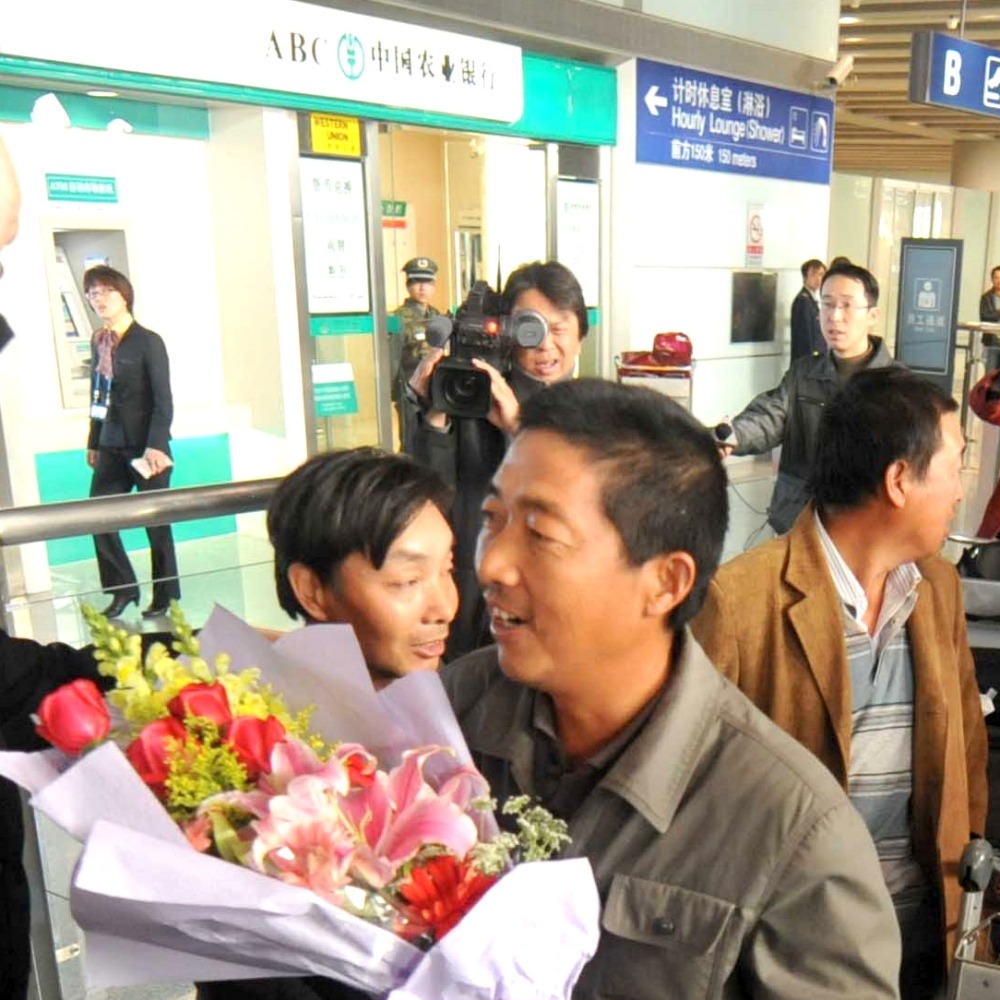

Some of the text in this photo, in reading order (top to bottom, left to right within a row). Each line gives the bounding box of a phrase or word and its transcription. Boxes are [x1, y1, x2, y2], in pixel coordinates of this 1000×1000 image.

[266, 30, 327, 65] ABC
[943, 49, 962, 96] B
[314, 115, 348, 129] WESTERN
[671, 105, 706, 137] Hourly
[718, 148, 731, 165] 150
[732, 151, 758, 168] meters
